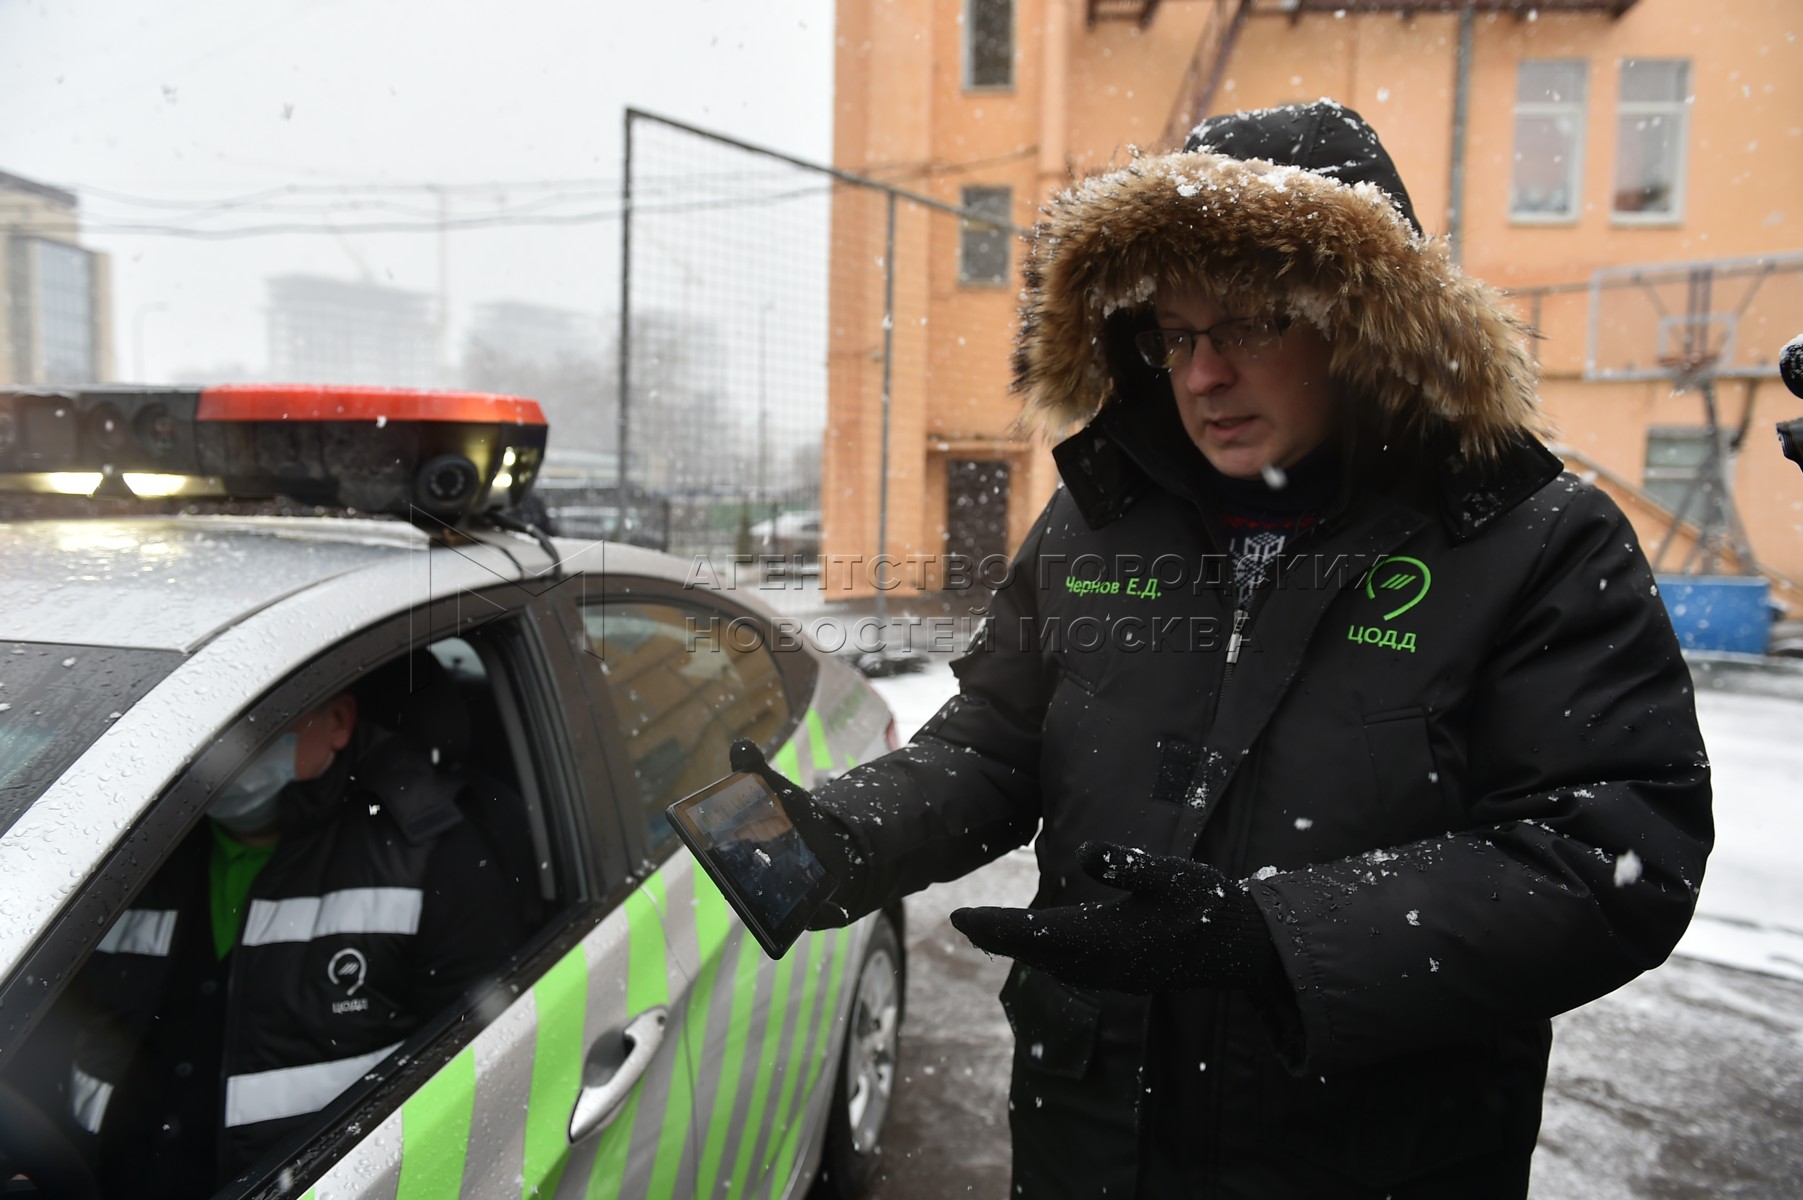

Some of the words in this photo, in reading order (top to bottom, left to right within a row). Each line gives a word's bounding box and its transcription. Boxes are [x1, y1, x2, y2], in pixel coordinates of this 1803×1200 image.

[1065, 576, 1120, 597] Чернов
[1126, 578, 1162, 599] Е.Д.
[1347, 625, 1417, 653] ЦОДД
